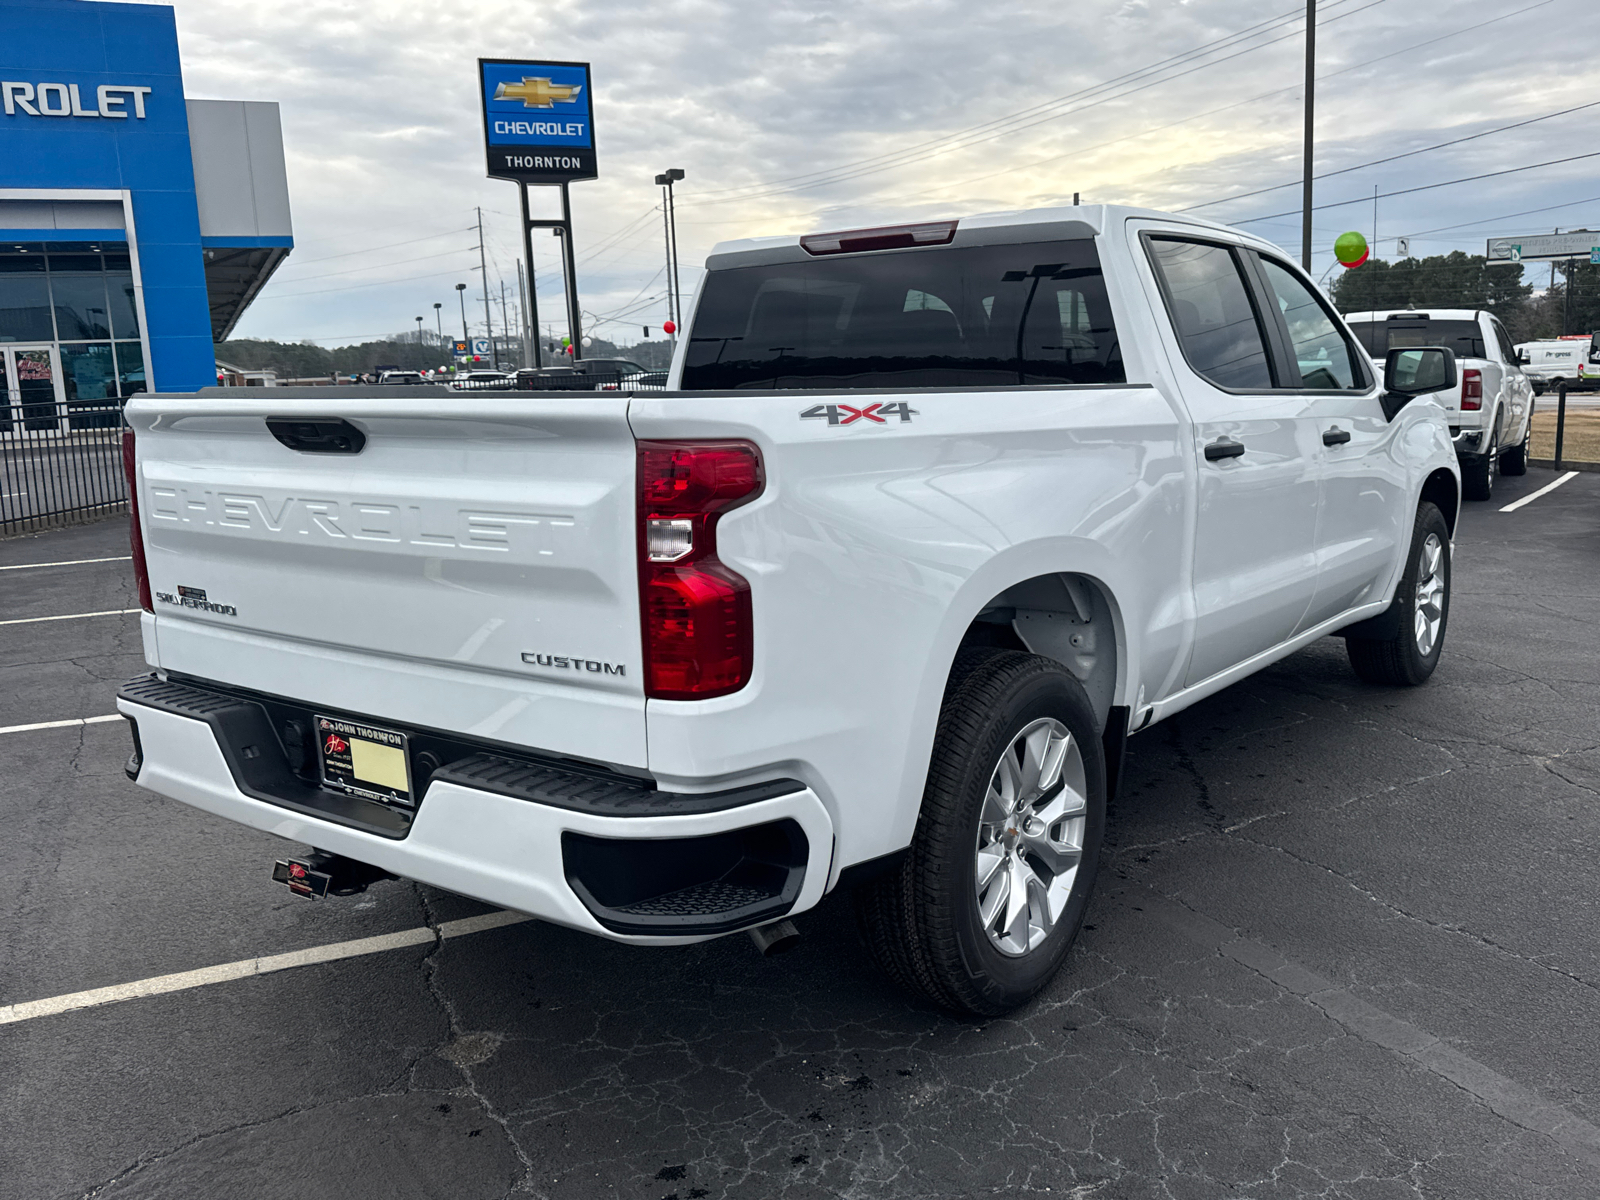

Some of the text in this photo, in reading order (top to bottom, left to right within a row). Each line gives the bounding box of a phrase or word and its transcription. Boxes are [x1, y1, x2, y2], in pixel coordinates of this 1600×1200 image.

[1, 81, 152, 119] ROLET
[494, 121, 585, 136] CHEVROLET
[505, 156, 581, 169] THORNTON
[150, 486, 575, 555] CHEVROLET
[156, 591, 237, 616] SILVERADO
[521, 652, 626, 676] CUSTOM
[334, 722, 356, 735] JOHN
[356, 728, 402, 745] THORNTON
[353, 789, 380, 800] CHEVROLET
